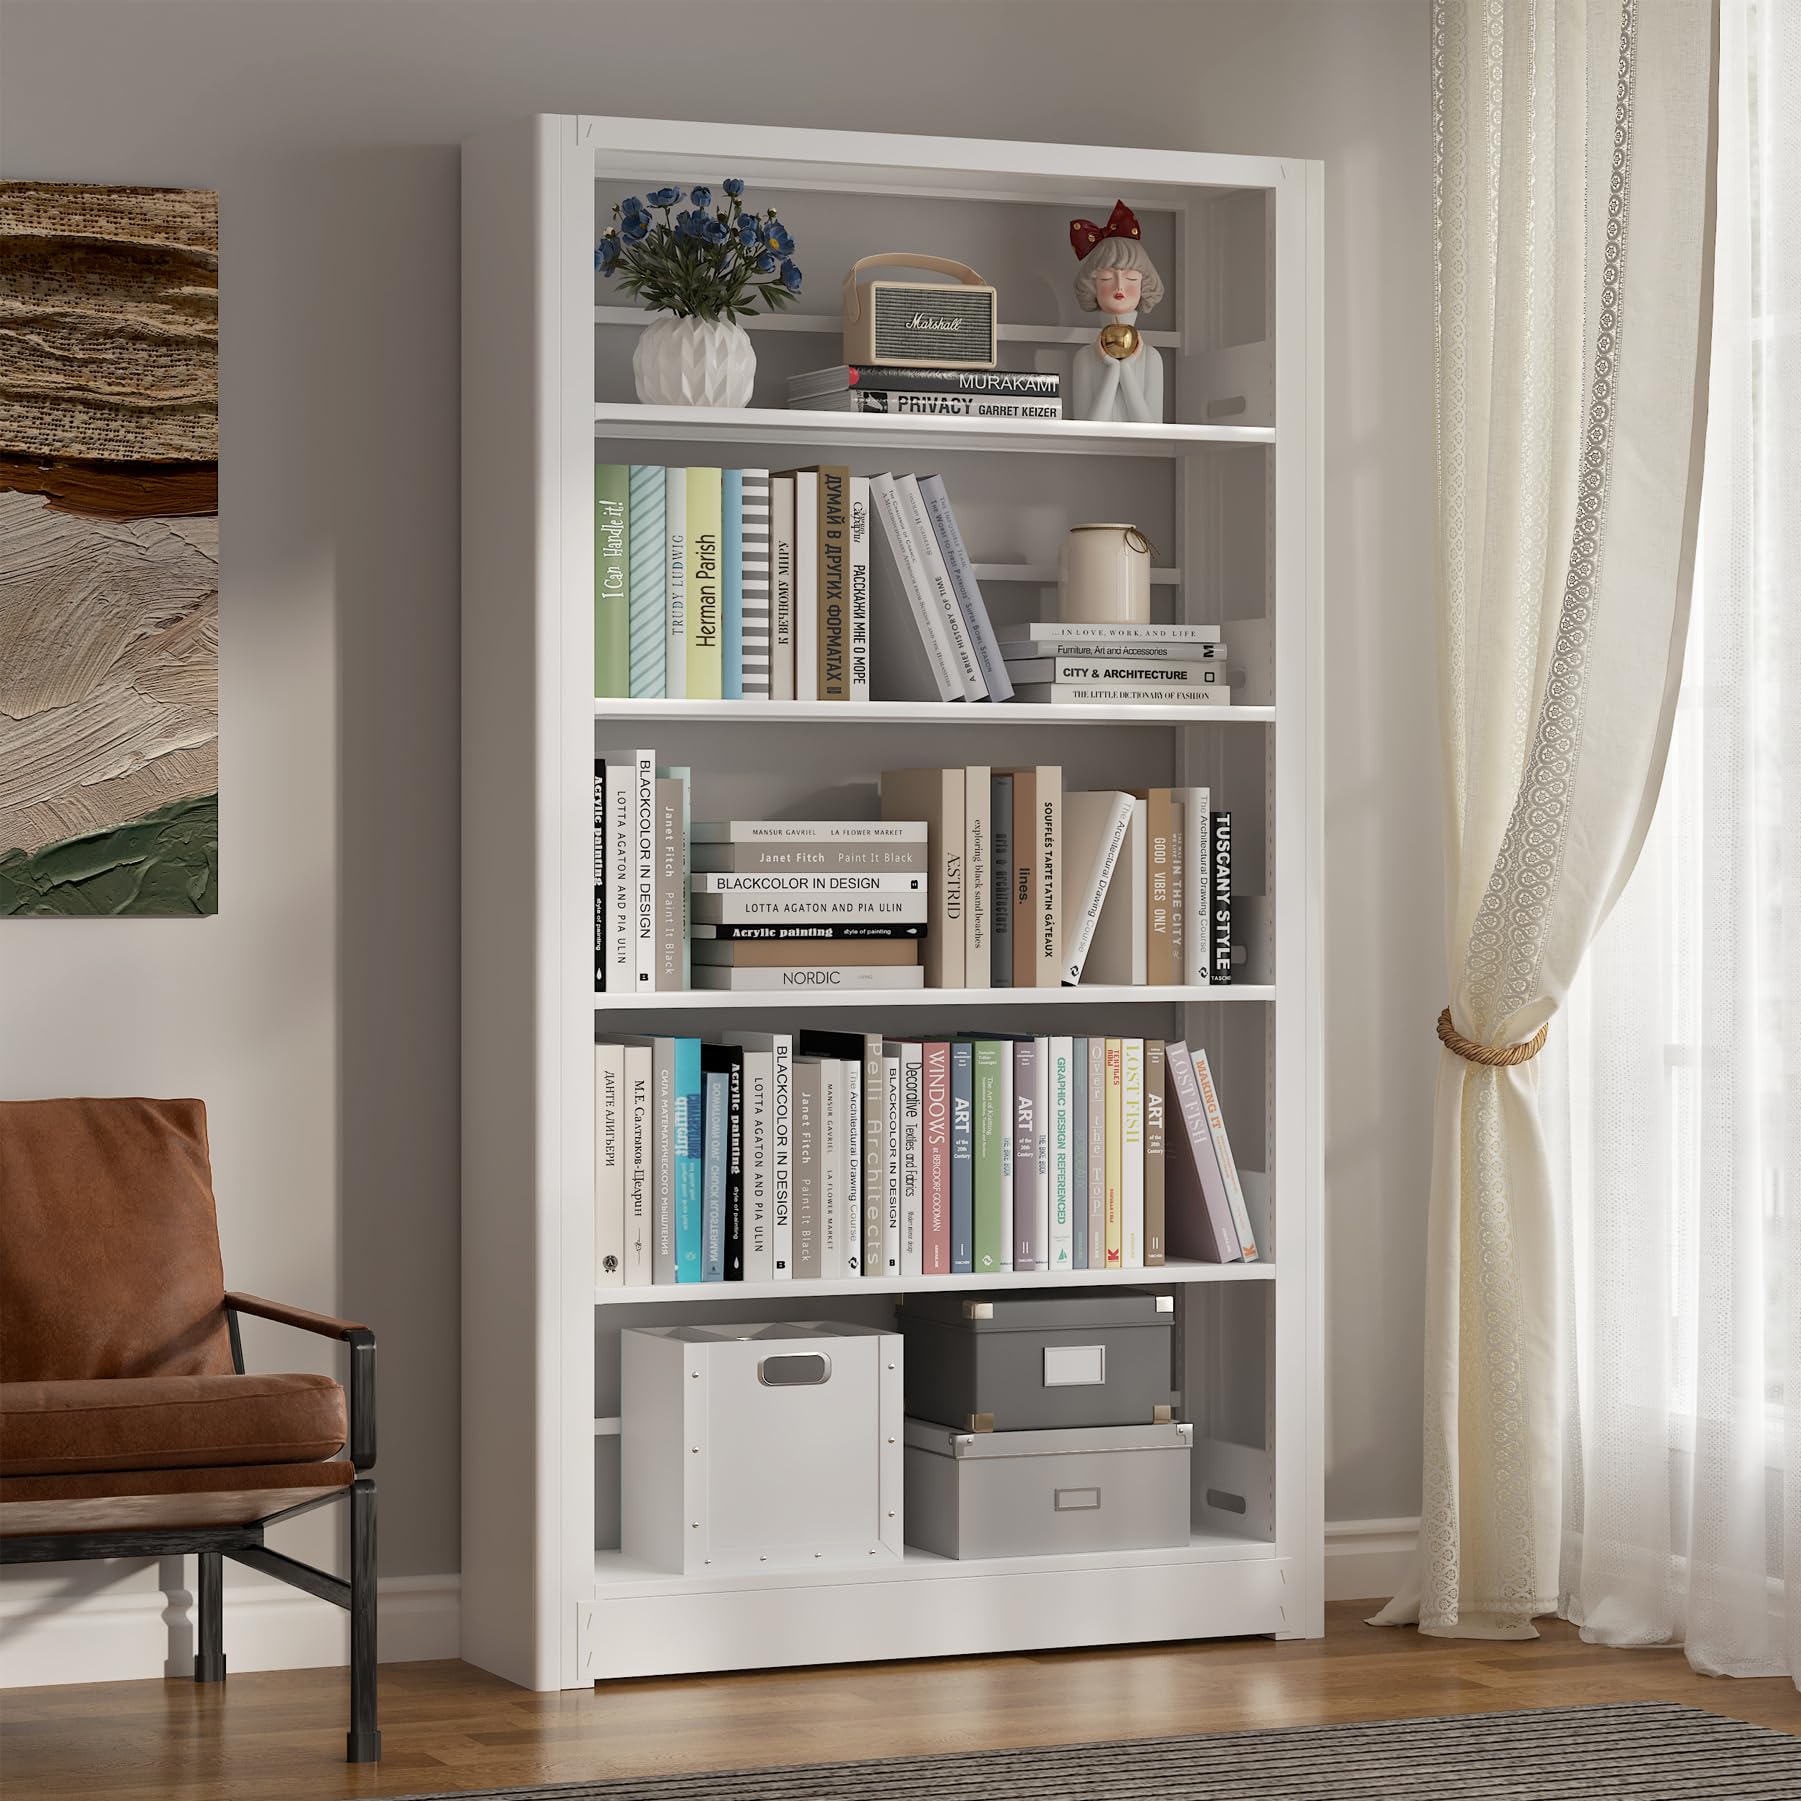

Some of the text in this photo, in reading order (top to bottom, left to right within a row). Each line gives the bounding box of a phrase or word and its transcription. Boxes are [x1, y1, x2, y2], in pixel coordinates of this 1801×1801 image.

[906, 312, 962, 331] Marshall
[897, 395, 1057, 418] PRIVACY GARRET KEIZER
[959, 373, 1060, 393] MURAKAMI
[825, 474, 845, 525] ДУМАЙ
[599, 500, 624, 599] I Can Handle it!
[826, 531, 842, 539] В
[672, 535, 684, 635] TRUDY LUDWIG
[696, 534, 716, 647] Herman Parish
[825, 545, 842, 599] ДРУГИХ
[853, 565, 866, 618] РАССКАЖИ
[935, 575, 947, 596] TIME
[853, 622, 866, 644] МНЕ
[942, 598, 952, 611] OF
[946, 612, 964, 648] HISTORY
[1146, 629, 1167, 637] AND
[1172, 629, 1197, 637] LIFE
[826, 604, 842, 681] ФОРМАТАХ
[853, 657, 866, 685] МОРЕ
[959, 650, 972, 673] BRIEF
[1057, 645, 1168, 656] Furniture, Art and Accessories
[1063, 668, 1188, 680] CITY & ARCHITECTURE
[1073, 690, 1210, 700] THE LITTLE DICTIONARY OF FASHION
[617, 791, 627, 964] LOTTA AGATON AND PIA ULIN
[640, 760, 651, 938] BLACKCOLOR IN DESIGN
[760, 853, 913, 863] Janet Fitch Paint It Black
[1079, 802, 1131, 953] The Architectural Drawing Course
[665, 806, 674, 975] Janet Fitch Paint It Black
[717, 877, 880, 890] BLACKCOLOR IN DESIGN
[745, 903, 903, 913] LOTTA AGATON AND PIA ULIN
[947, 852, 961, 919] ÆSTRID
[972, 819, 983, 949] exploring black sand beaches
[1019, 868, 1030, 904] lines.
[1045, 802, 1055, 958] SOUFFLÉS TARTE TATIN GÂTEAUX
[1154, 838, 1166, 934] GOOD VIBES ONLY
[1172, 880, 1182, 907] THE
[1199, 878, 1208, 915] Drawing
[1216, 814, 1231, 970] TUSCANY STYLE
[732, 928, 833, 939] Acrylic painting
[1172, 913, 1182, 945] CITY
[783, 971, 841, 985] NORDIC
[605, 1070, 615, 1166] ДАНТЕ АЛИГЬЕРИ
[730, 1063, 740, 1175] Acrylic painting
[929, 1049, 945, 1145] WINDOWS
[955, 1097, 970, 1133] ART
[1018, 1096, 1032, 1132] ART
[1126, 1045, 1140, 1143] LOST FISH
[1149, 1094, 1162, 1128] ART
[1171, 1050, 1207, 1145] LOST FISH
[1196, 1060, 1221, 1129] MAKING IT
[777, 1045, 787, 1226] BLACKCOLOR IN DESIGN
[848, 1071, 858, 1242] The Architectural Drawing Course
[868, 1043, 882, 1265] Pelli Architects
[889, 1068, 897, 1228] BLACKCOLOR IN DESIGN
[905, 1062, 922, 1197] Decorative Textiles and Fabrics
[1057, 1057, 1066, 1225] GRAPHIC DESIGN REFERENCED
[631, 1107, 645, 1216] Салтыков-Щедрин
[661, 1069, 669, 1255] СИЛА МАТЕМАТИЧЕСКОГО МЫШЛЕНИЯ
[754, 1077, 763, 1252] LOTTA AGATON AND PIA ULIN
[802, 1092, 811, 1262] Janet Fitch Paint It Black
